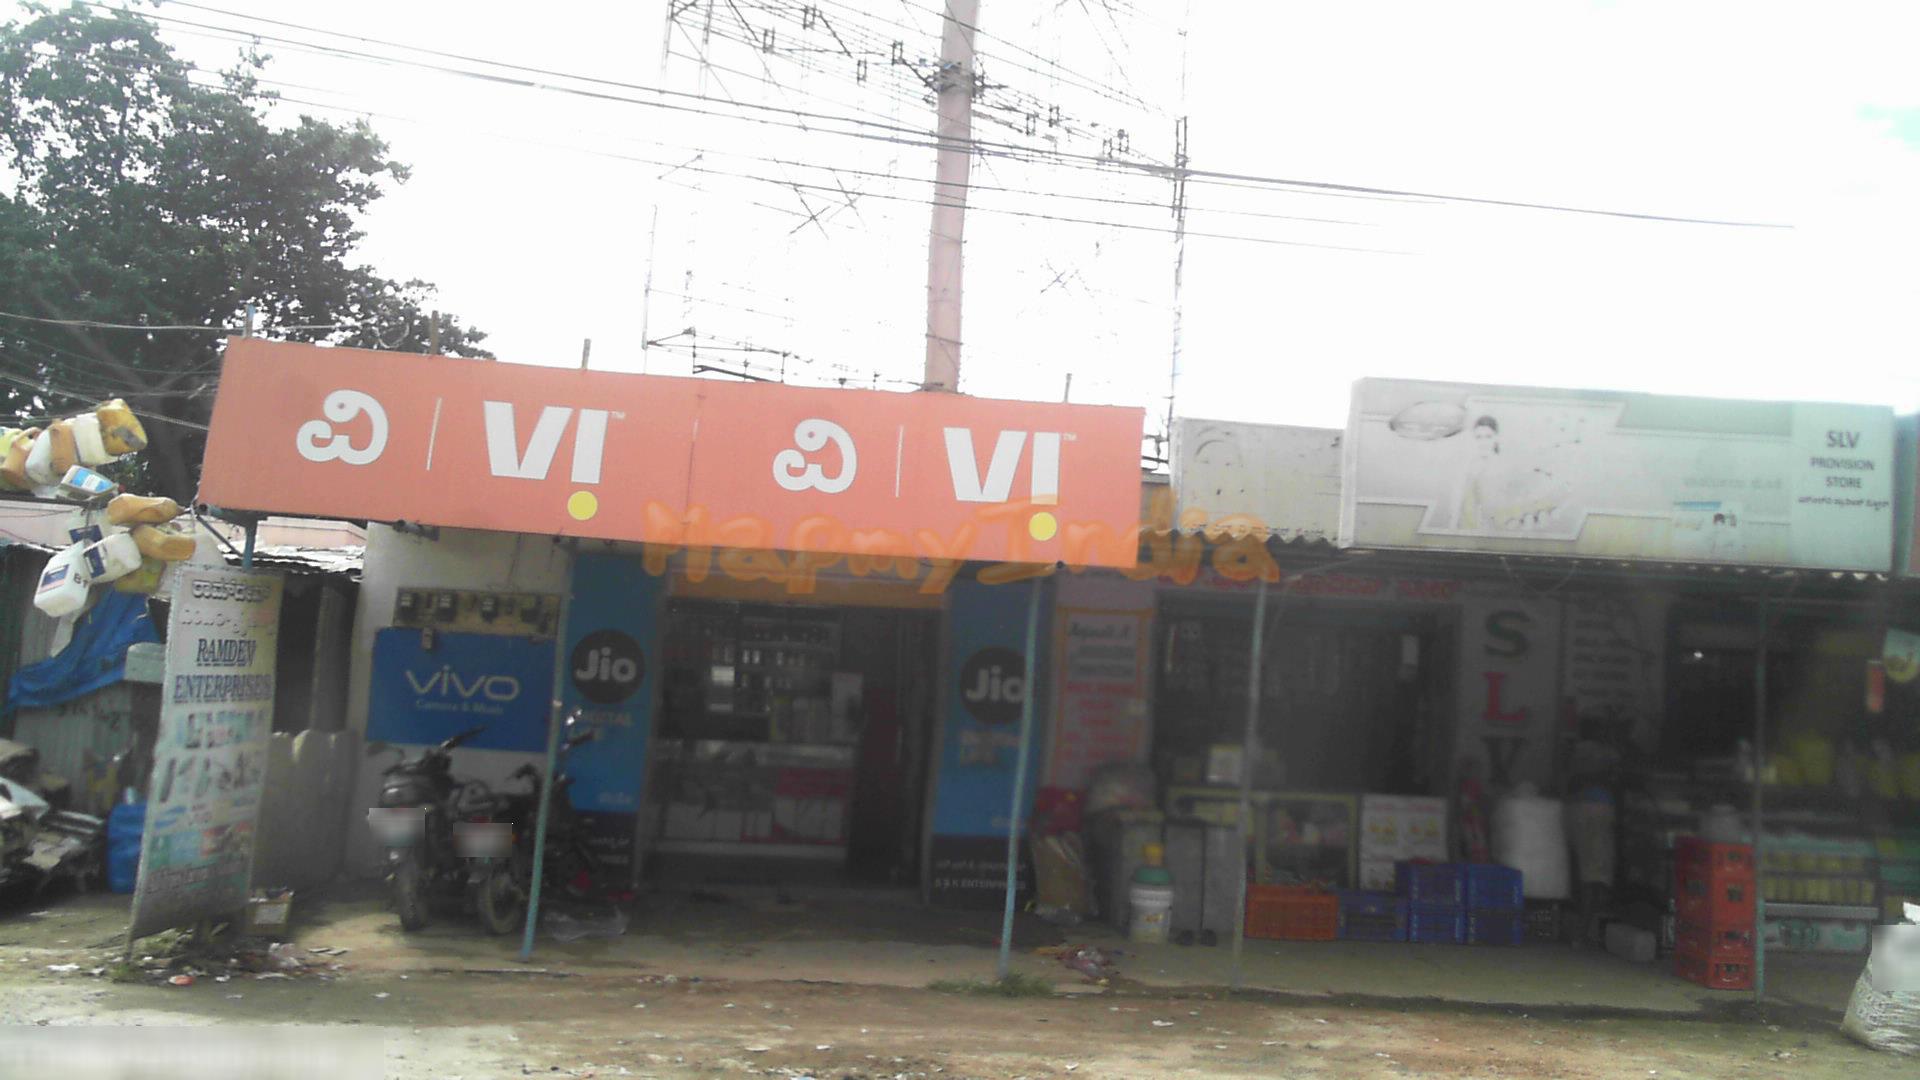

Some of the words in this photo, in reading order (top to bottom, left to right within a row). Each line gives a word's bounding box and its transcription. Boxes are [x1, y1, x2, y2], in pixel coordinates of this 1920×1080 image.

[296, 389, 389, 465] ವಿ
[1825, 429, 1861, 449] SLV
[772, 418, 858, 494] ವಿ
[1809, 456, 1876, 471] PROVISION
[1825, 475, 1863, 489] STORE
[196, 638, 257, 667] RAMDEV
[575, 645, 638, 683] Jio
[173, 674, 273, 704] ENTERPRISES
[405, 664, 522, 702] vivo
[965, 665, 1026, 704] Jio
